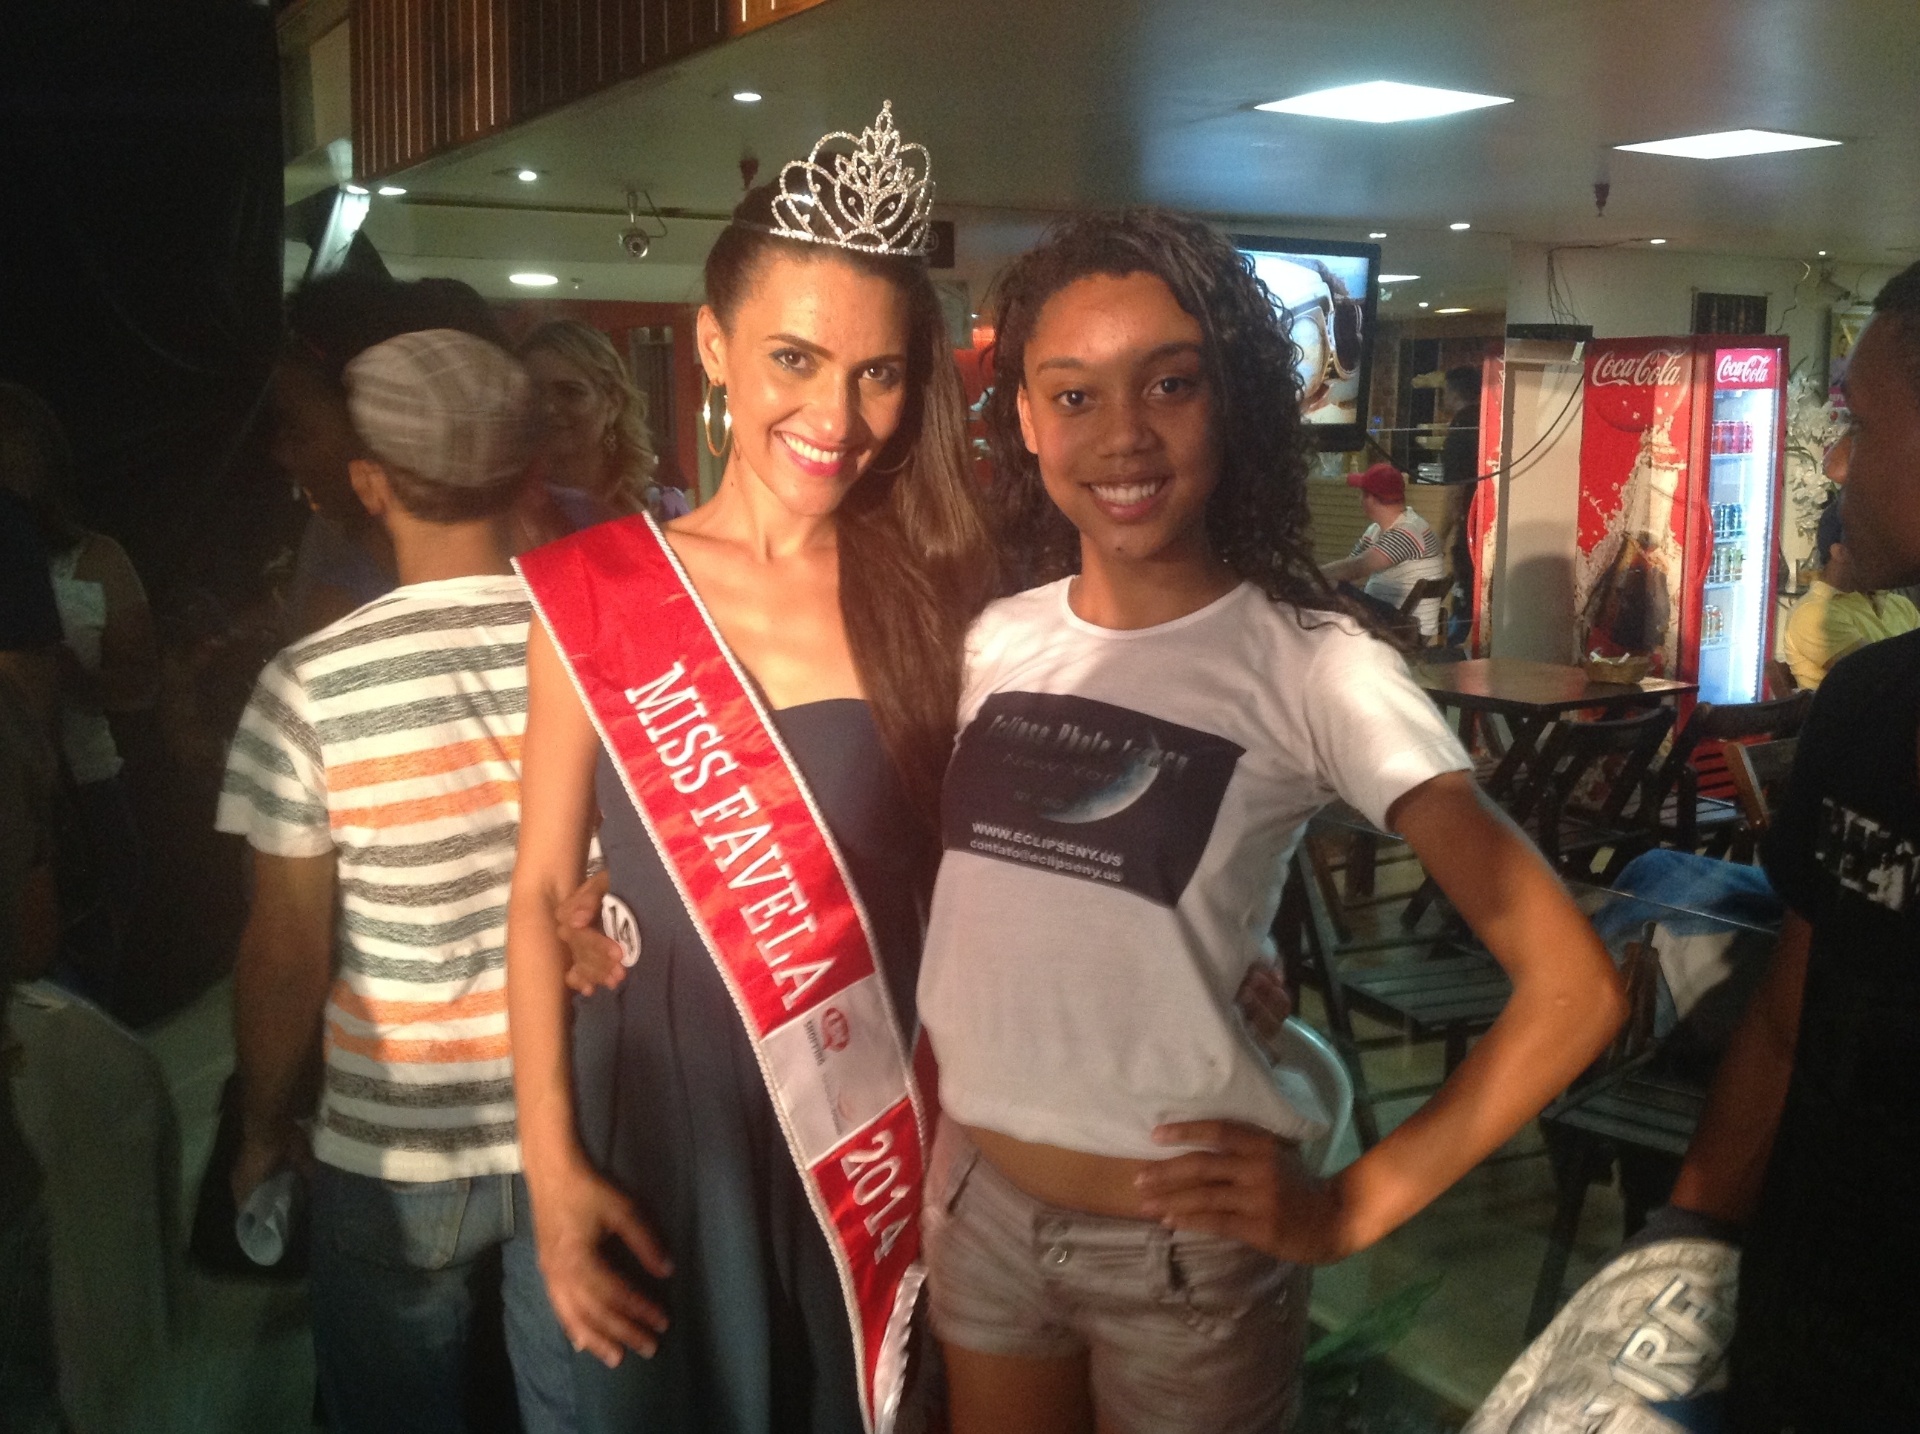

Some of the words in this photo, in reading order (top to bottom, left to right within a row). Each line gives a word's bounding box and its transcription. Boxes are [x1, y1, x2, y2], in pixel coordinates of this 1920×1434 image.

[1591, 348, 1685, 387] Coca-Cola
[1716, 354, 1771, 383] Coca-Cola
[625, 661, 739, 795] MISS
[681, 785, 837, 1012] FAVELA
[840, 1129, 912, 1266] 2014
